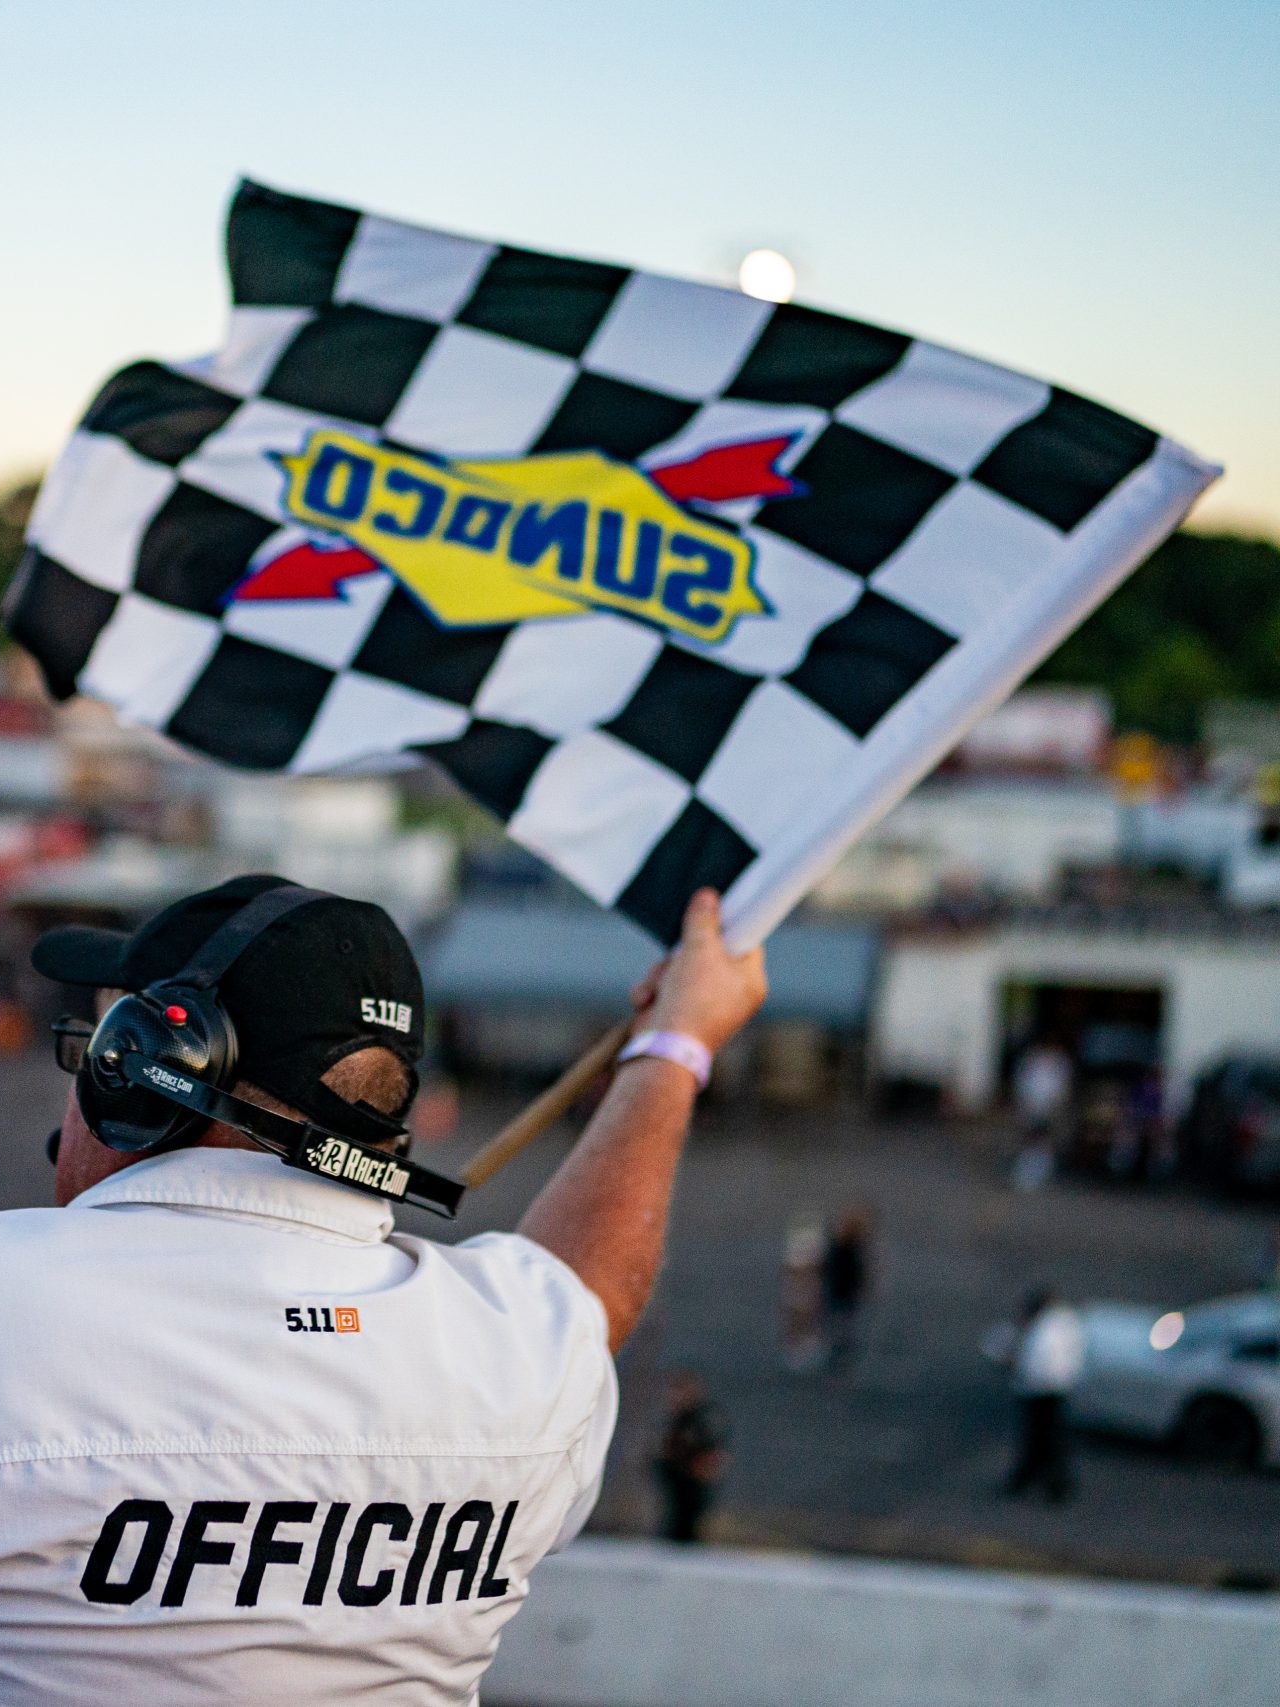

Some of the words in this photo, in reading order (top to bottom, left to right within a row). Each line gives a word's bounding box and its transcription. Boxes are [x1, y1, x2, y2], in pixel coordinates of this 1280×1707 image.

[360, 997, 398, 1029] 5.11
[285, 1307, 336, 1333] 5.11
[79, 1498, 520, 1608] OFFICIAL
